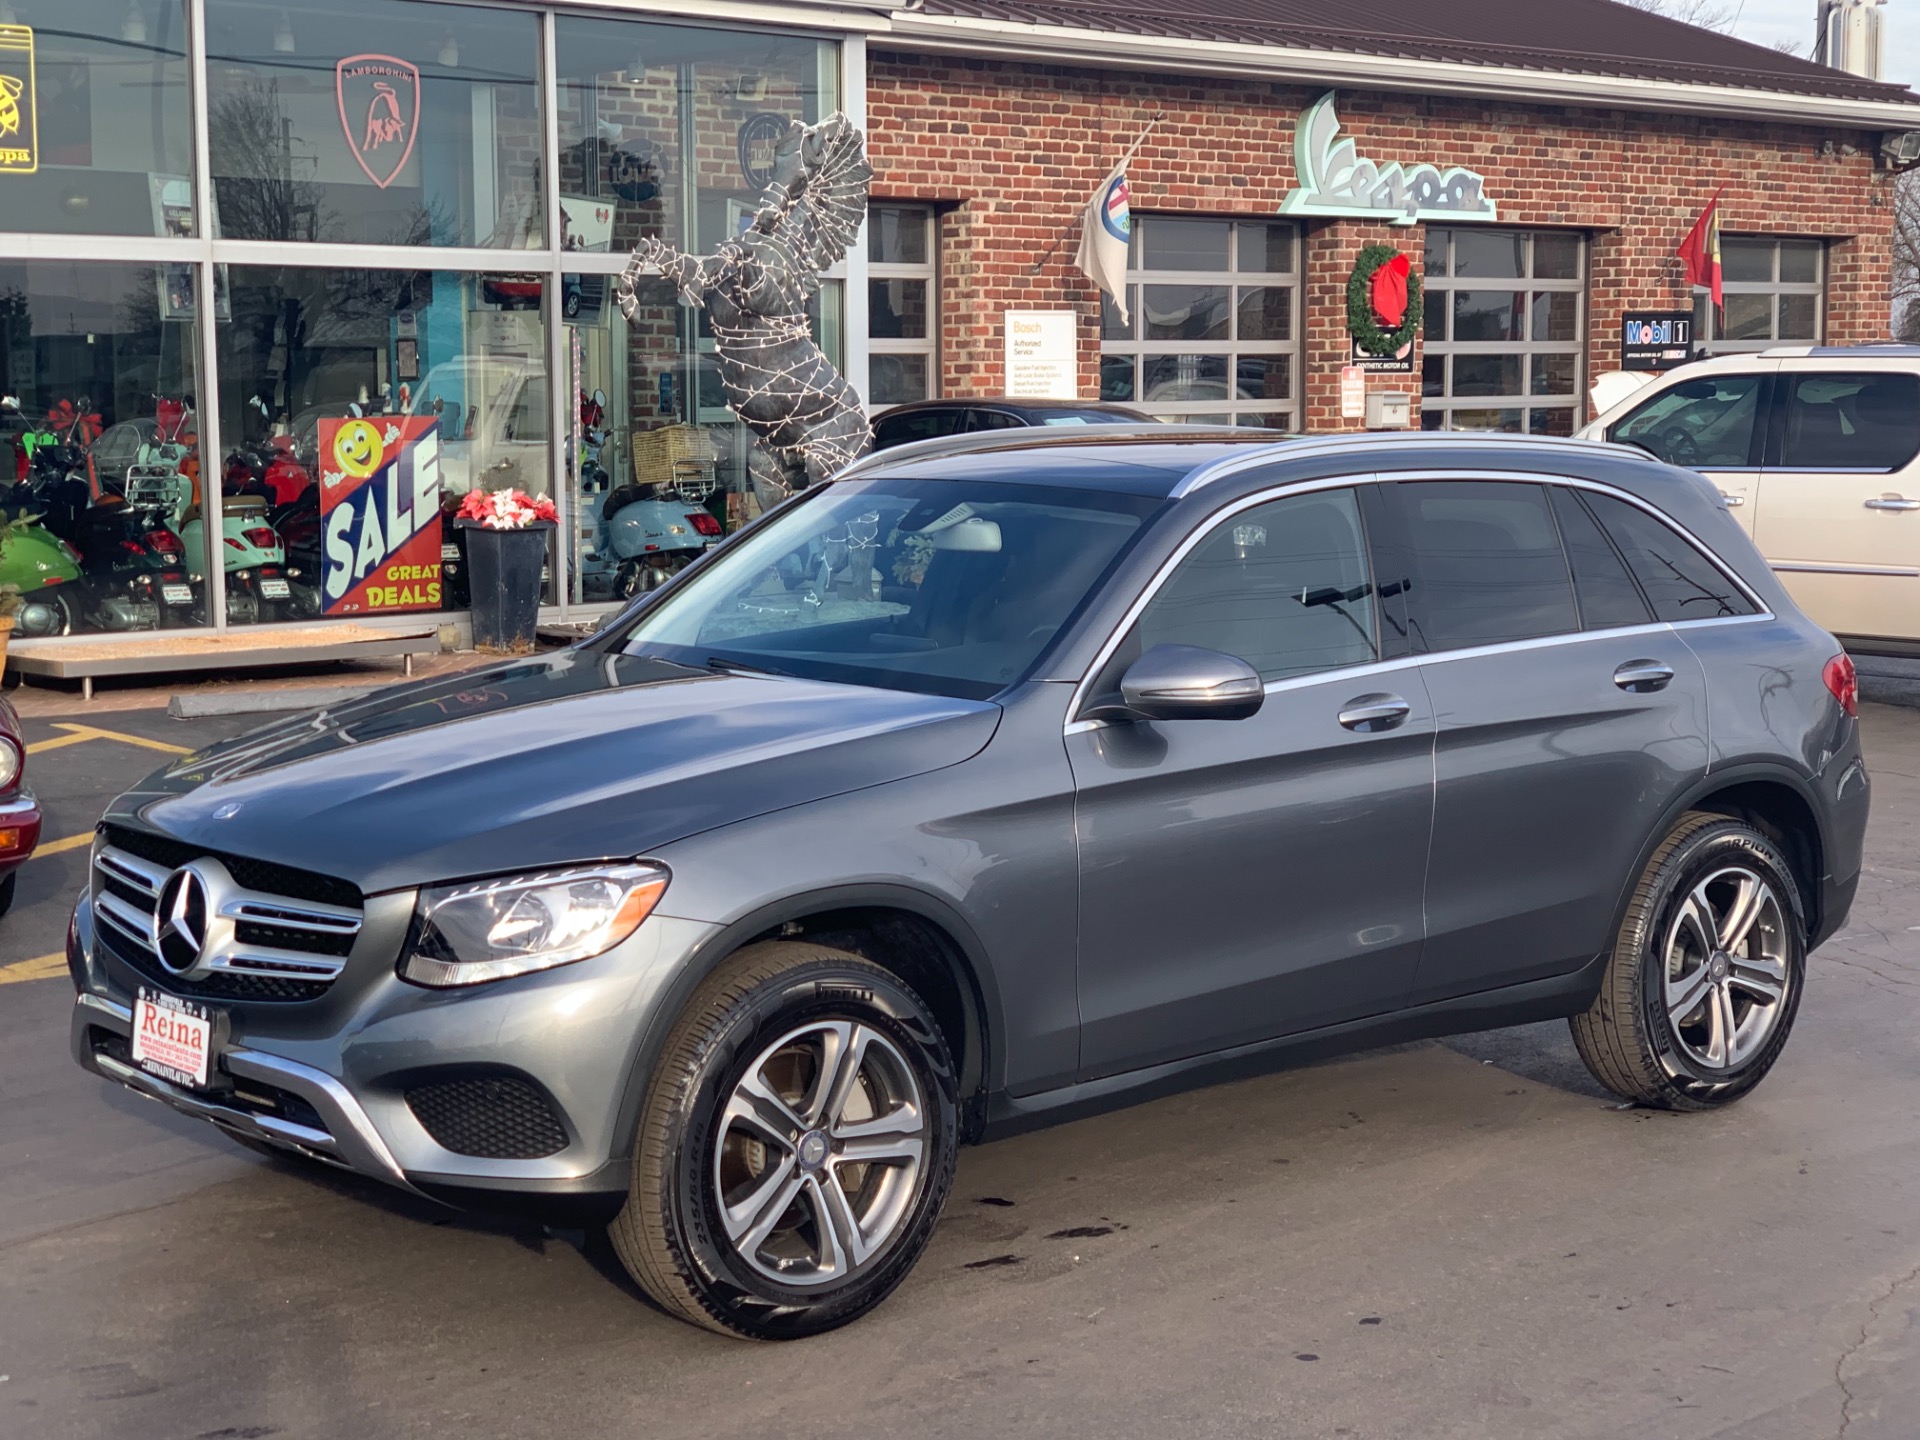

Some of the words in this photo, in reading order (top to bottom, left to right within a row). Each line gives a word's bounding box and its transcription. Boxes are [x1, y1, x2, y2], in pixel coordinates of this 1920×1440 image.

[345, 66, 412, 82] LAMBORGHINI
[1290, 93, 1496, 222] Vespa
[1013, 321, 1042, 333] Bosch
[1627, 320, 1671, 344] Mobil
[326, 429, 439, 599] SALE
[387, 564, 440, 581] GREAT
[366, 583, 440, 606] DEALS
[141, 1002, 202, 1050] Reina
[689, 1168, 709, 1245] 235/60
